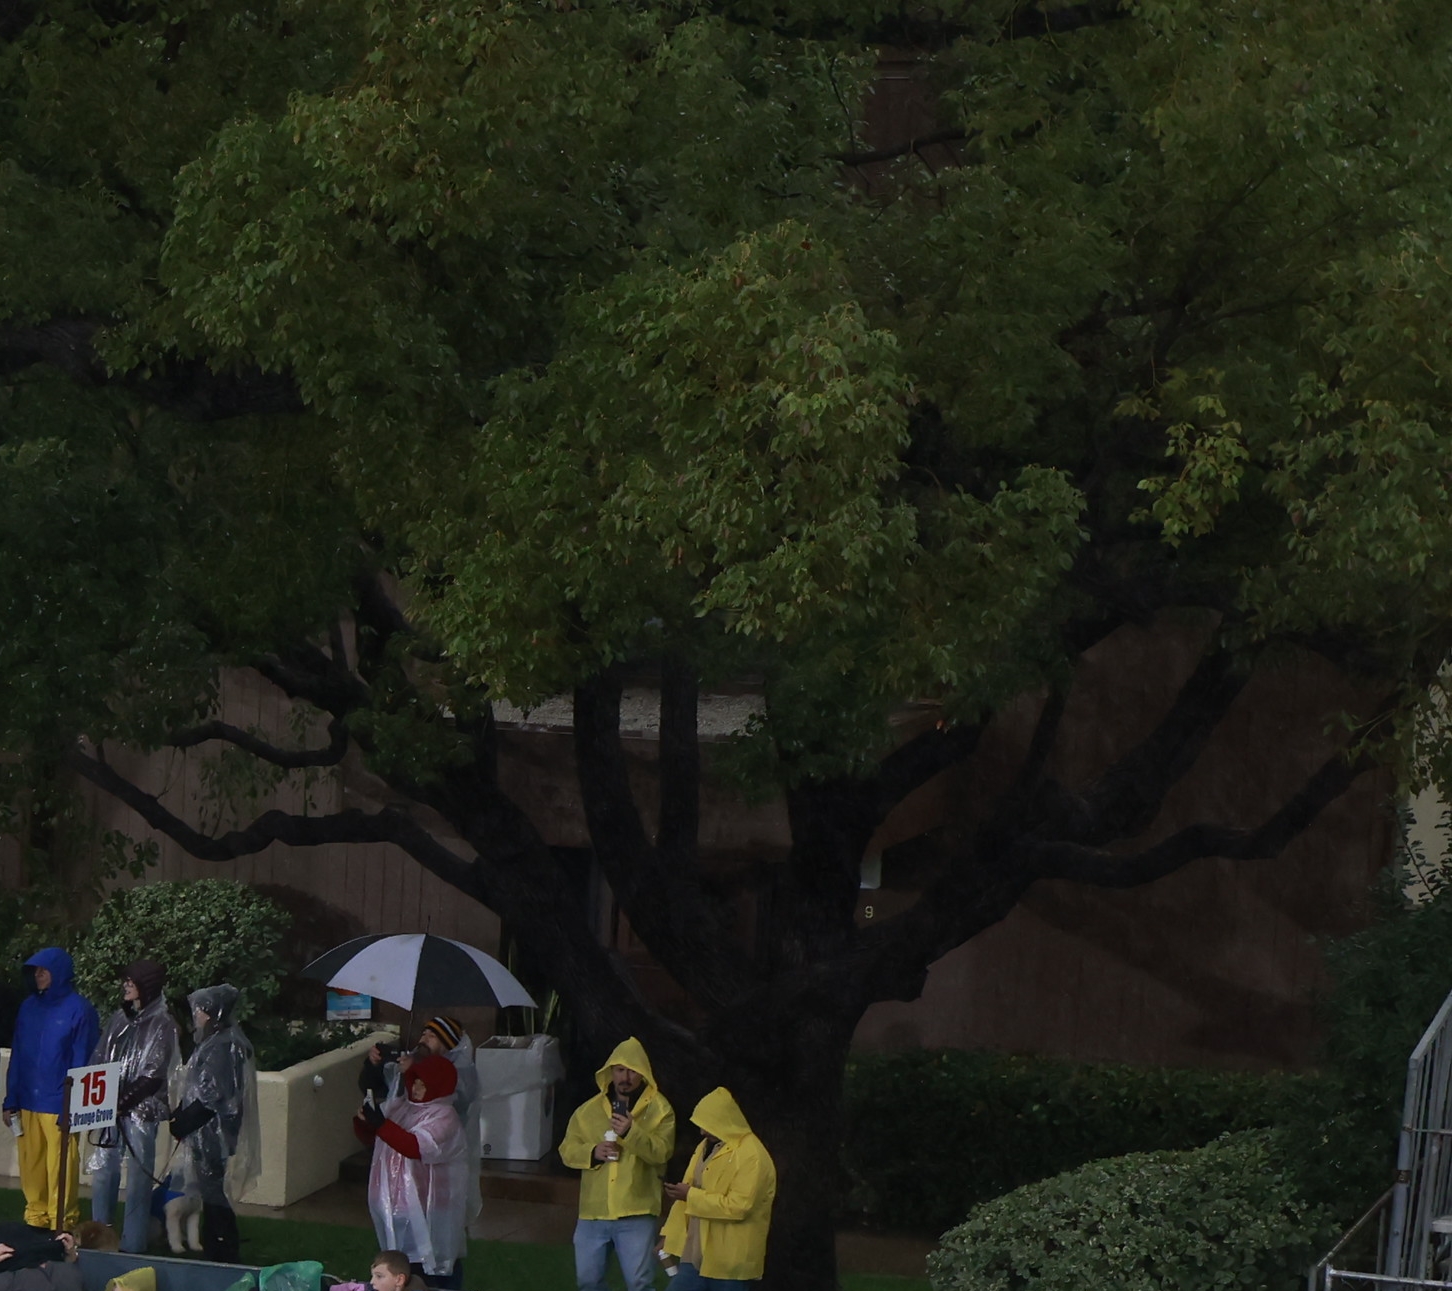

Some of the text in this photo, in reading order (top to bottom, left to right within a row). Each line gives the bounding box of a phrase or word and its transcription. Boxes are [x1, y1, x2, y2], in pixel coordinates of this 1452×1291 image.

[80, 1070, 107, 1107] 15
[74, 1111, 96, 1127] Orange
[96, 1108, 113, 1122] Grove
